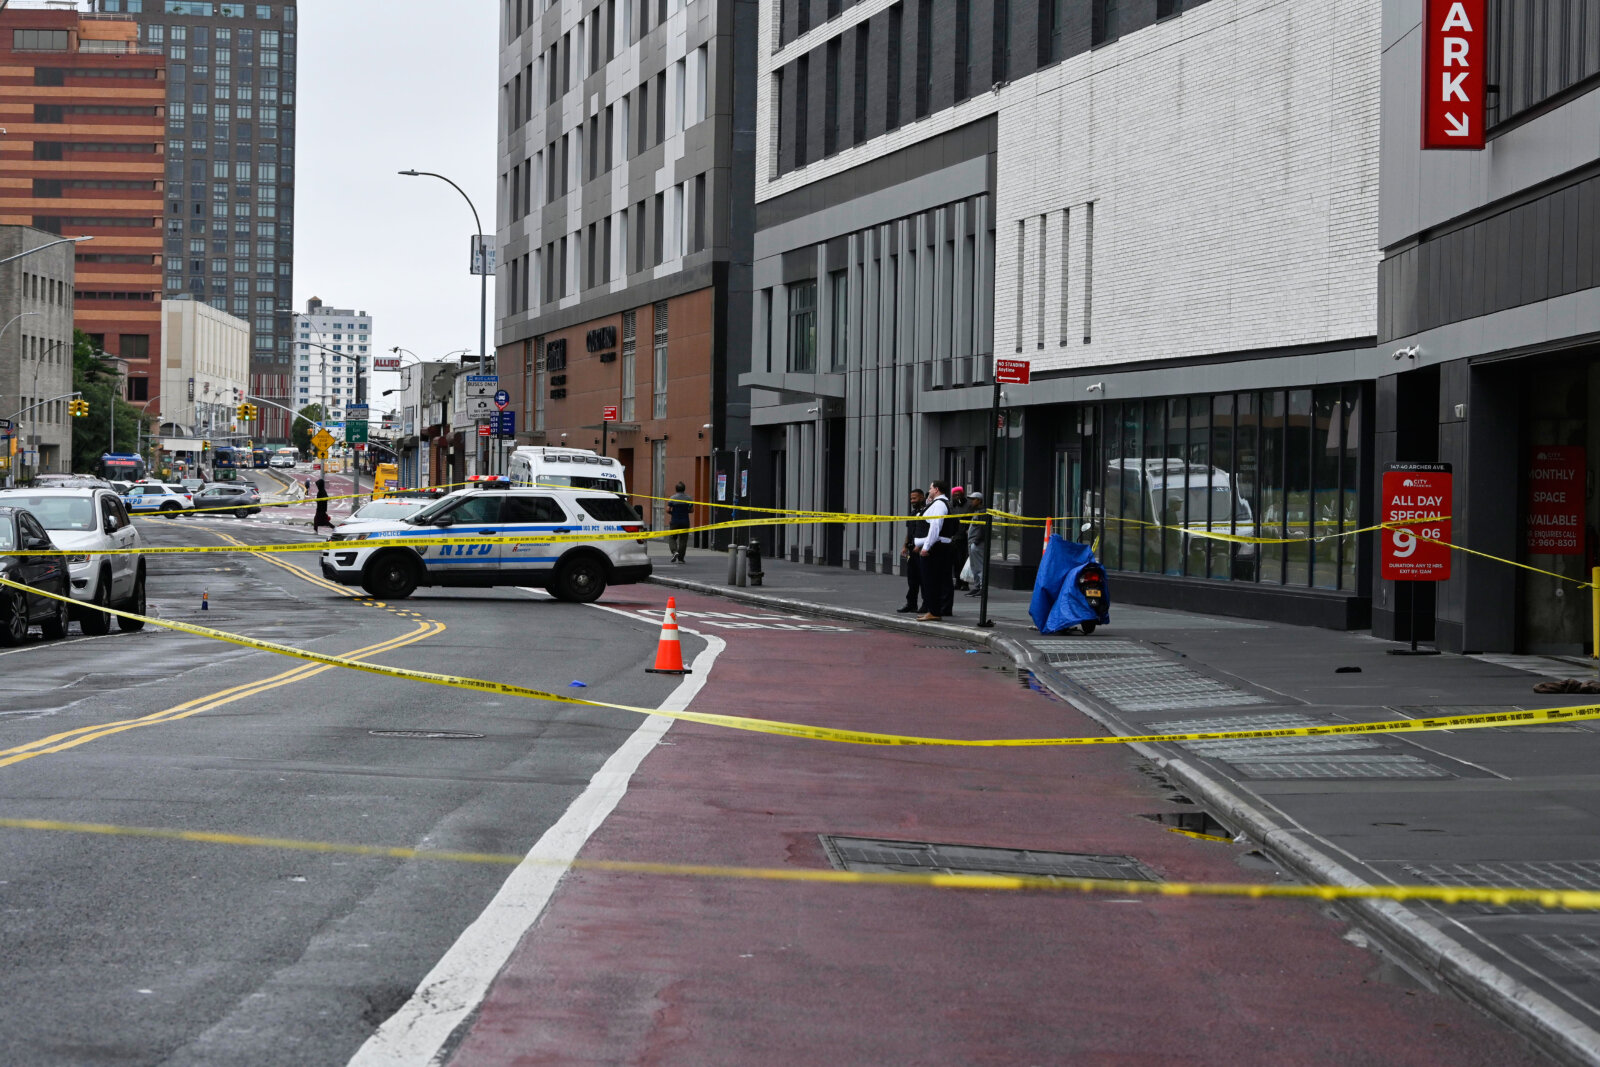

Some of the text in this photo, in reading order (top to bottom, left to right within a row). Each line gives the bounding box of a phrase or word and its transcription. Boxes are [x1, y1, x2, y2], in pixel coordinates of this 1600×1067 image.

[375, 359, 400, 367] ALLIED
[1391, 496, 1443, 506] ALL DAY
[1534, 491, 1566, 503] SPACE
[1392, 528, 1440, 558] 9 06
[440, 544, 493, 556] NYPD
